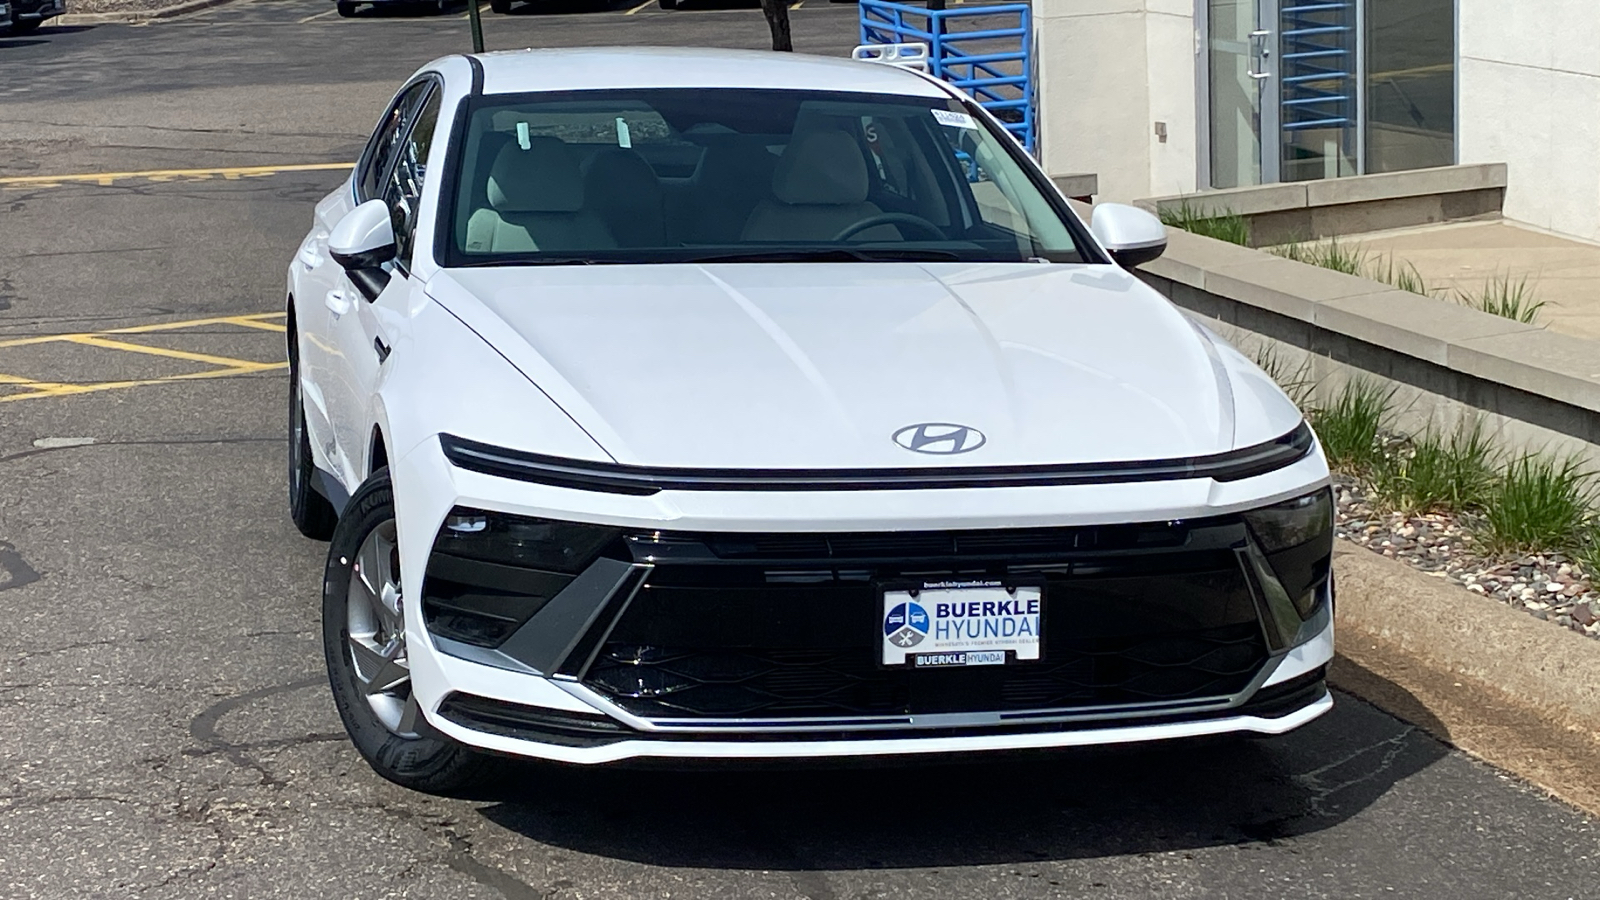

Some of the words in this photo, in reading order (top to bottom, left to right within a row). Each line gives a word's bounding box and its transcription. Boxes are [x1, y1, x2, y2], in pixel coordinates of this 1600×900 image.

[361, 490, 390, 514] KUM
[936, 600, 1039, 618] BUERKLE
[936, 616, 1039, 640] HYUNDAI
[917, 654, 966, 666] BUERKLE
[966, 652, 1004, 663] HYUNDAI
